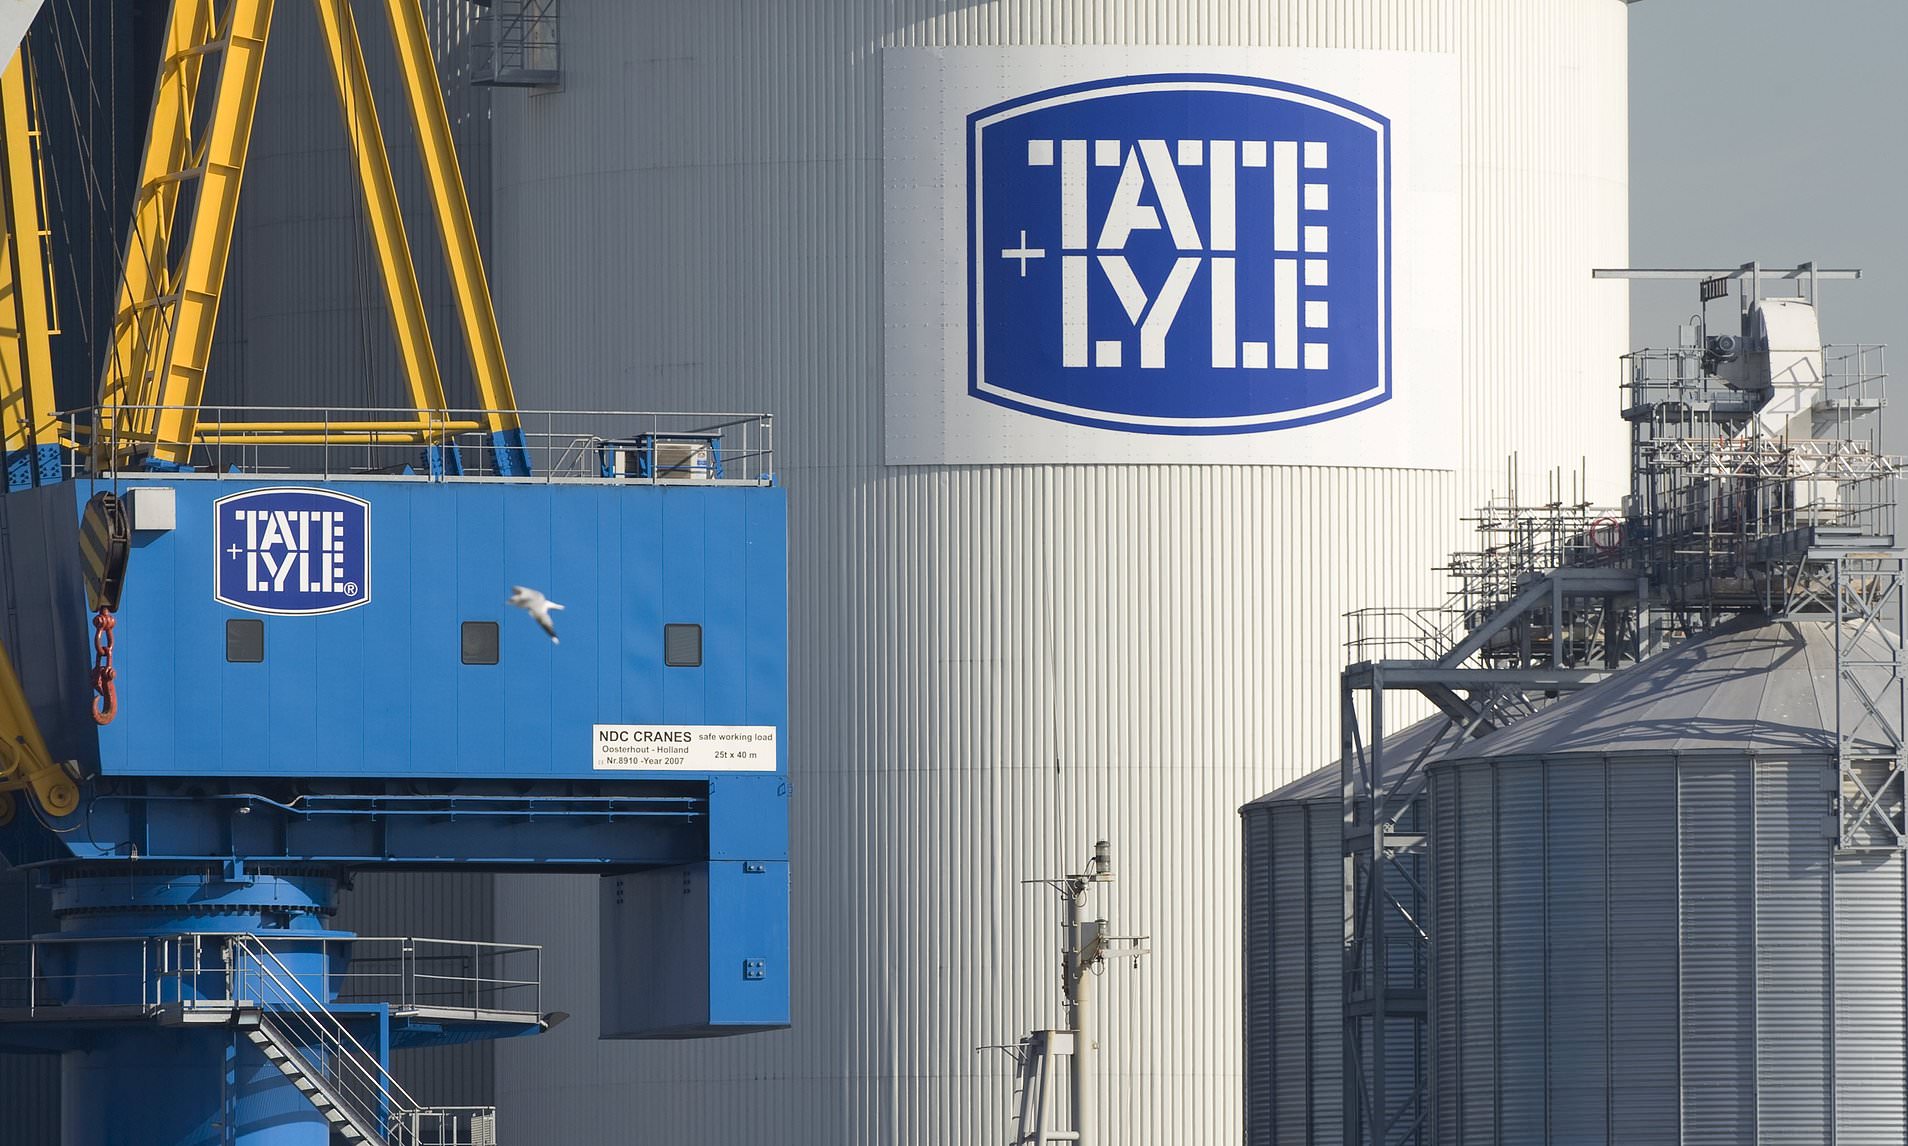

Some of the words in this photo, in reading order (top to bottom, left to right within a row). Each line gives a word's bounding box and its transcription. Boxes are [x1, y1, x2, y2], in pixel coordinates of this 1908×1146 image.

[1028, 139, 1329, 252] TATE
[1062, 255, 1329, 370] LYLE
[235, 510, 344, 551] TATE
[599, 730, 629, 742] NDC
[633, 731, 692, 743] CRANES
[698, 733, 717, 741] safe
[718, 733, 753, 743] working
[754, 733, 773, 741] load
[602, 745, 650, 754] Oosterhout
[656, 746, 689, 754] Holland
[714, 751, 728, 759] 25t
[736, 751, 747, 759] 40
[664, 757, 685, 765] 2007
